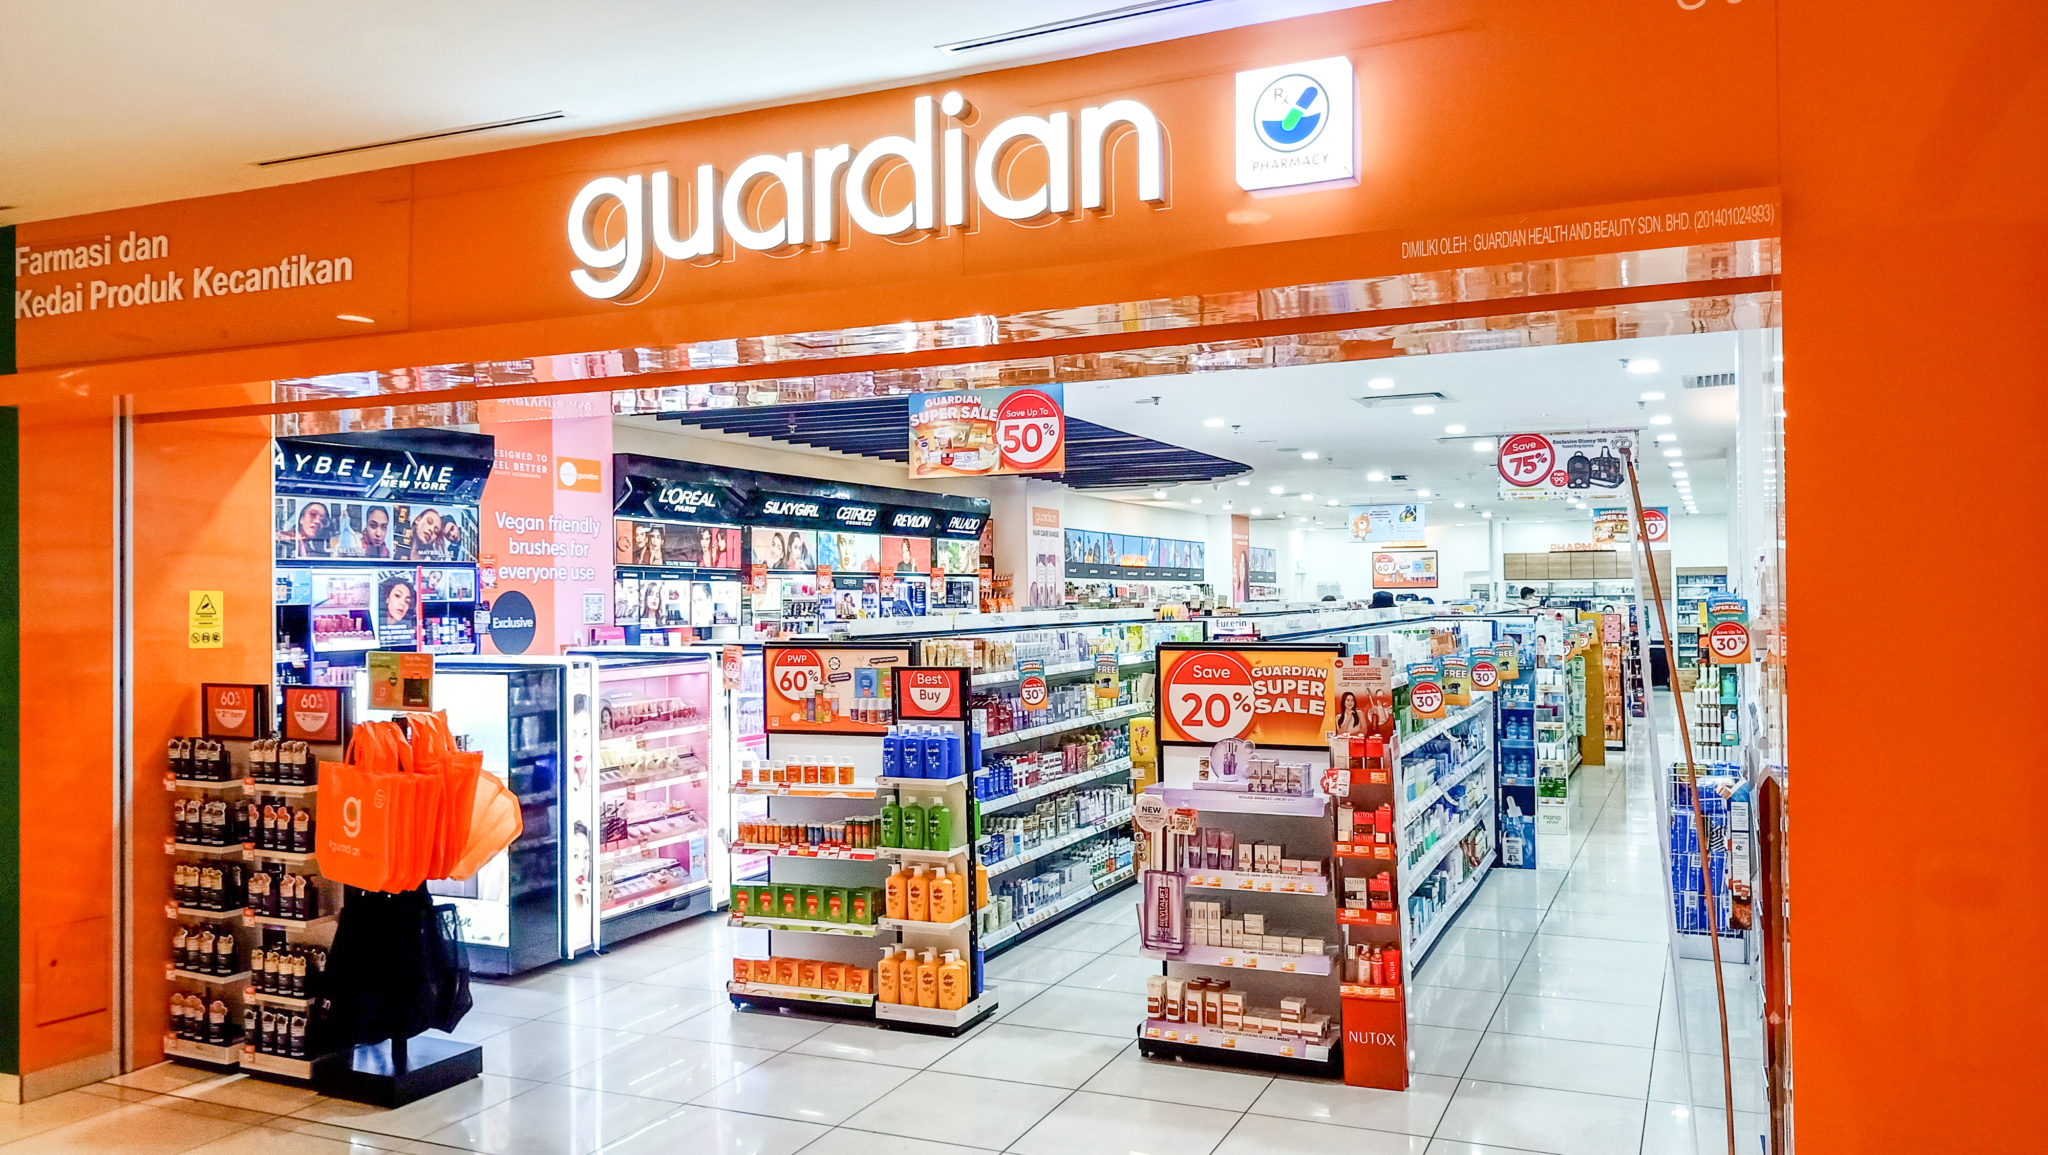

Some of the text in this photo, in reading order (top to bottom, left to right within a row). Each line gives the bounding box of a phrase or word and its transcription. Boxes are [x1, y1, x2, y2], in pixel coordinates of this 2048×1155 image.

[1252, 153, 1328, 171] PHARMACY
[566, 91, 1166, 301] guardian
[1401, 238, 1438, 259] DIMILIKI
[1439, 236, 1467, 255] OLEH
[1473, 230, 1526, 251] GUARDIAN
[1528, 224, 1568, 247] HEALTH
[1568, 222, 1592, 241] AND
[1593, 217, 1637, 239] BEAUTY
[1638, 215, 1663, 235] SDN.
[1665, 212, 1692, 232] BHD.
[1694, 203, 1775, 233] (201401024993)
[15, 231, 169, 277] Farmasi dan
[15, 254, 353, 320] Kedai Produk Kecantikan
[924, 395, 982, 408] GUARDIAN
[910, 406, 999, 427] SUPER SALE
[1006, 408, 1049, 418] Save Up To
[1003, 422, 1055, 454] 50%
[1512, 441, 1537, 452] Save
[494, 449, 548, 463] ESIGNED TO
[274, 451, 454, 483] AYBELLINE
[493, 460, 548, 474] EEL BETTER
[1509, 452, 1548, 476] 75%
[380, 479, 448, 491] NEW YORK
[658, 487, 716, 508] L'ORÉAL
[674, 505, 697, 514] PARIS
[763, 500, 820, 518] SILKYGIRL
[495, 511, 601, 538] Vegan friendly
[893, 513, 932, 529] REVLON
[949, 516, 981, 530] PALLADIO
[509, 537, 590, 557] brushes for
[498, 566, 595, 585] everyone use
[492, 617, 534, 629] Exclusive
[1216, 619, 1247, 627] Eucerin
[1716, 637, 1746, 650] 30%
[787, 655, 807, 663] PWP
[1097, 665, 1116, 674] FREE
[1193, 665, 1231, 679] Save
[1251, 666, 1328, 679] GUARDIAN
[1443, 669, 1468, 679] FREE
[780, 669, 818, 691] 60%
[916, 673, 943, 685] Best
[1475, 673, 1495, 682] 30%
[1025, 689, 1044, 700] 30%
[1253, 679, 1326, 697] SUPER
[919, 689, 941, 702] Buy
[1416, 695, 1441, 708] 30%
[1181, 692, 1252, 728] 20%
[1254, 698, 1326, 716] SALE
[1141, 806, 1162, 814] NEW
[343, 797, 362, 838] g
[1348, 1031, 1397, 1047] NUTOX
